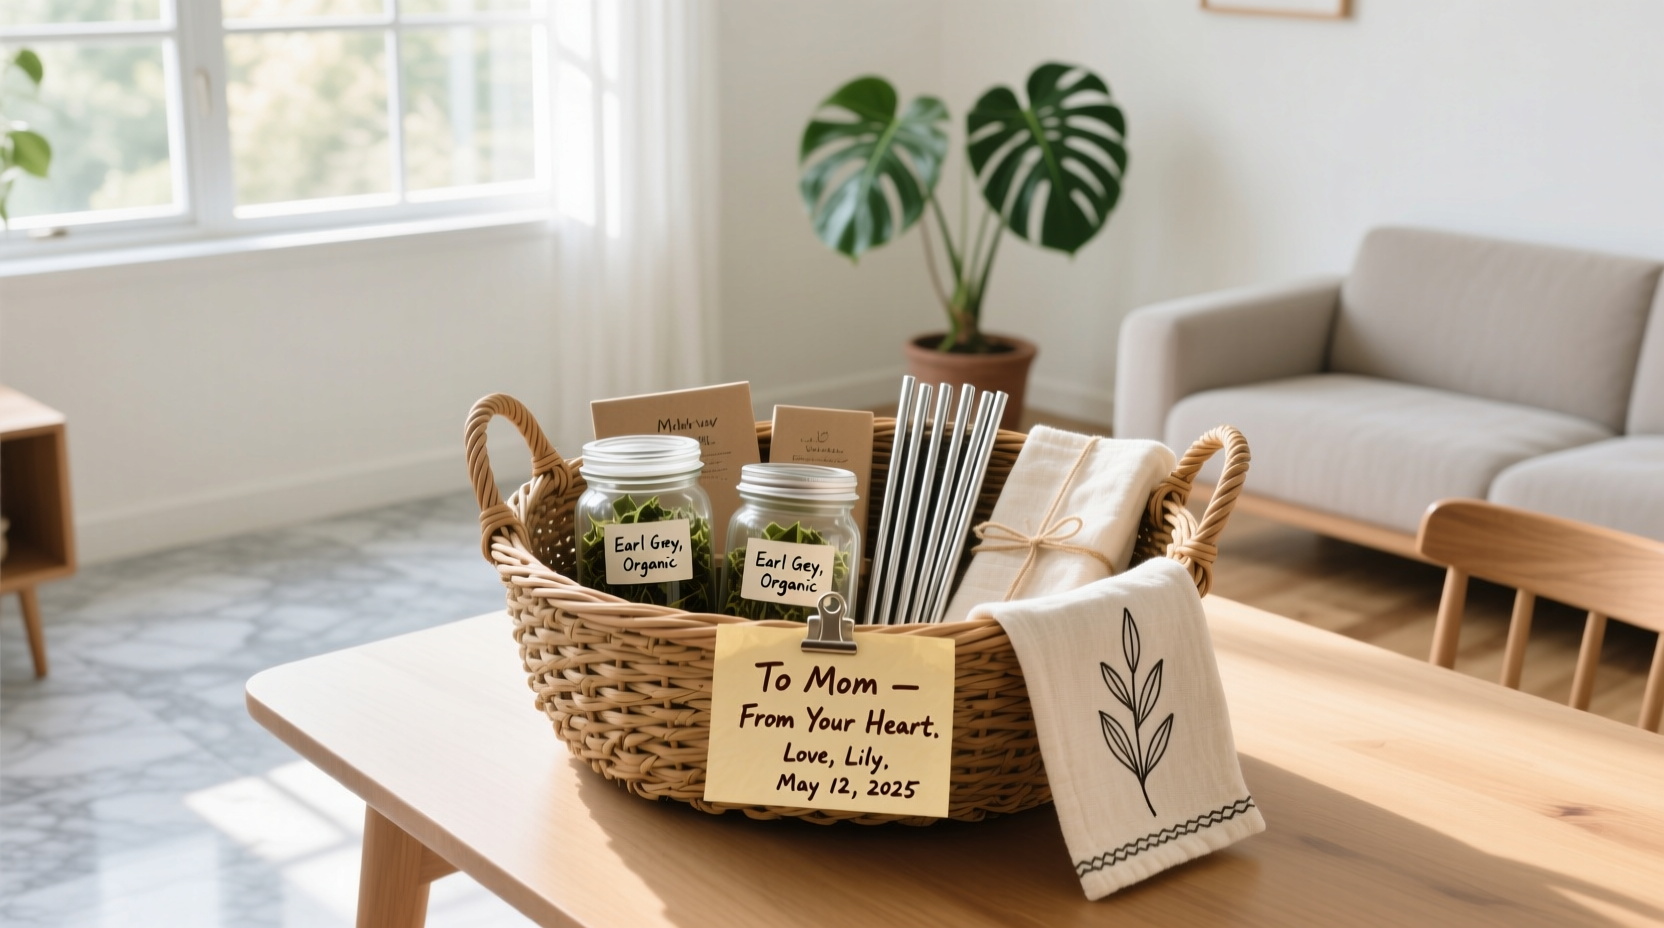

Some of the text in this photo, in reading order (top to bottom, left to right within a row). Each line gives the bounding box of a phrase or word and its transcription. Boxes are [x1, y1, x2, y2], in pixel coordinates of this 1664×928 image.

[615, 534, 645, 553] Earl
[623, 556, 677, 578] Organic
[755, 550, 787, 570] Earl
[760, 572, 818, 597] Organic
[754, 660, 792, 693] To
[803, 665, 878, 696] Mom
[739, 702, 939, 739] From Your Heart.
[783, 741, 835, 769] Love,
[776, 772, 921, 802] May 12, 2025
